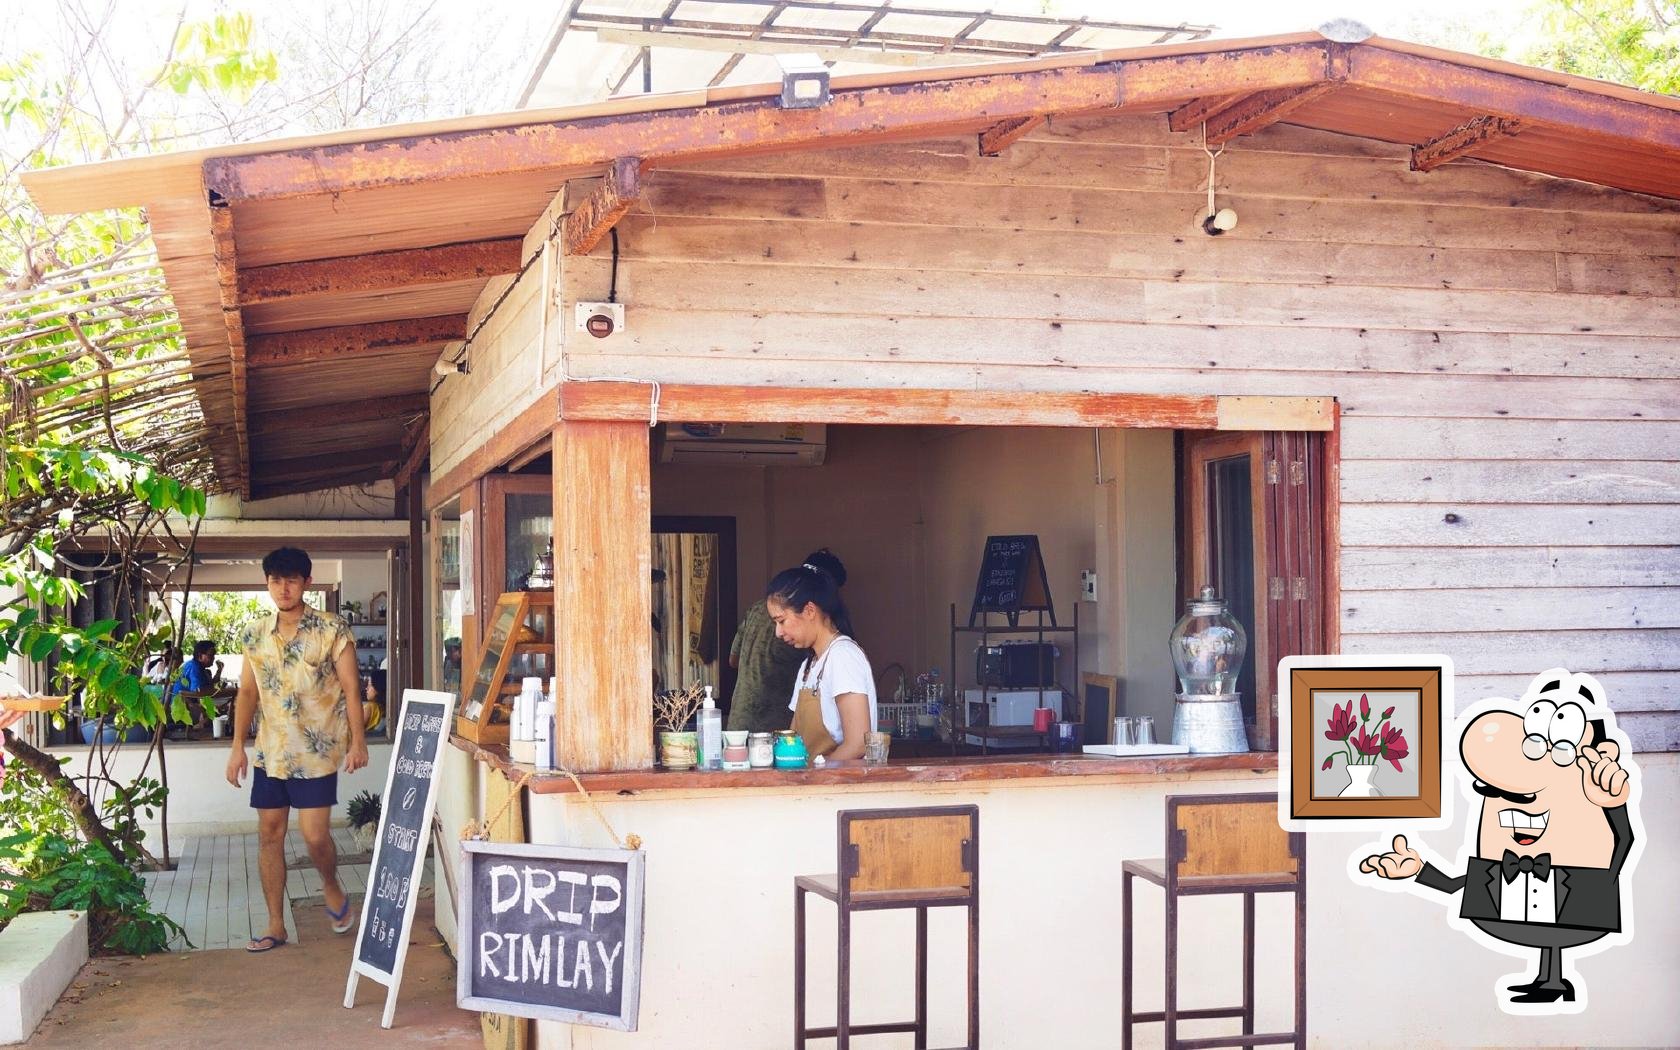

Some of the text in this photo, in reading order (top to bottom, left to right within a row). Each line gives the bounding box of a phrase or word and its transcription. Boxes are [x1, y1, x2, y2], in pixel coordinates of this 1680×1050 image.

[415, 735, 424, 754] &
[387, 823, 418, 852] START
[489, 865, 621, 931] DRIP
[480, 931, 622, 995] RIMLAY
